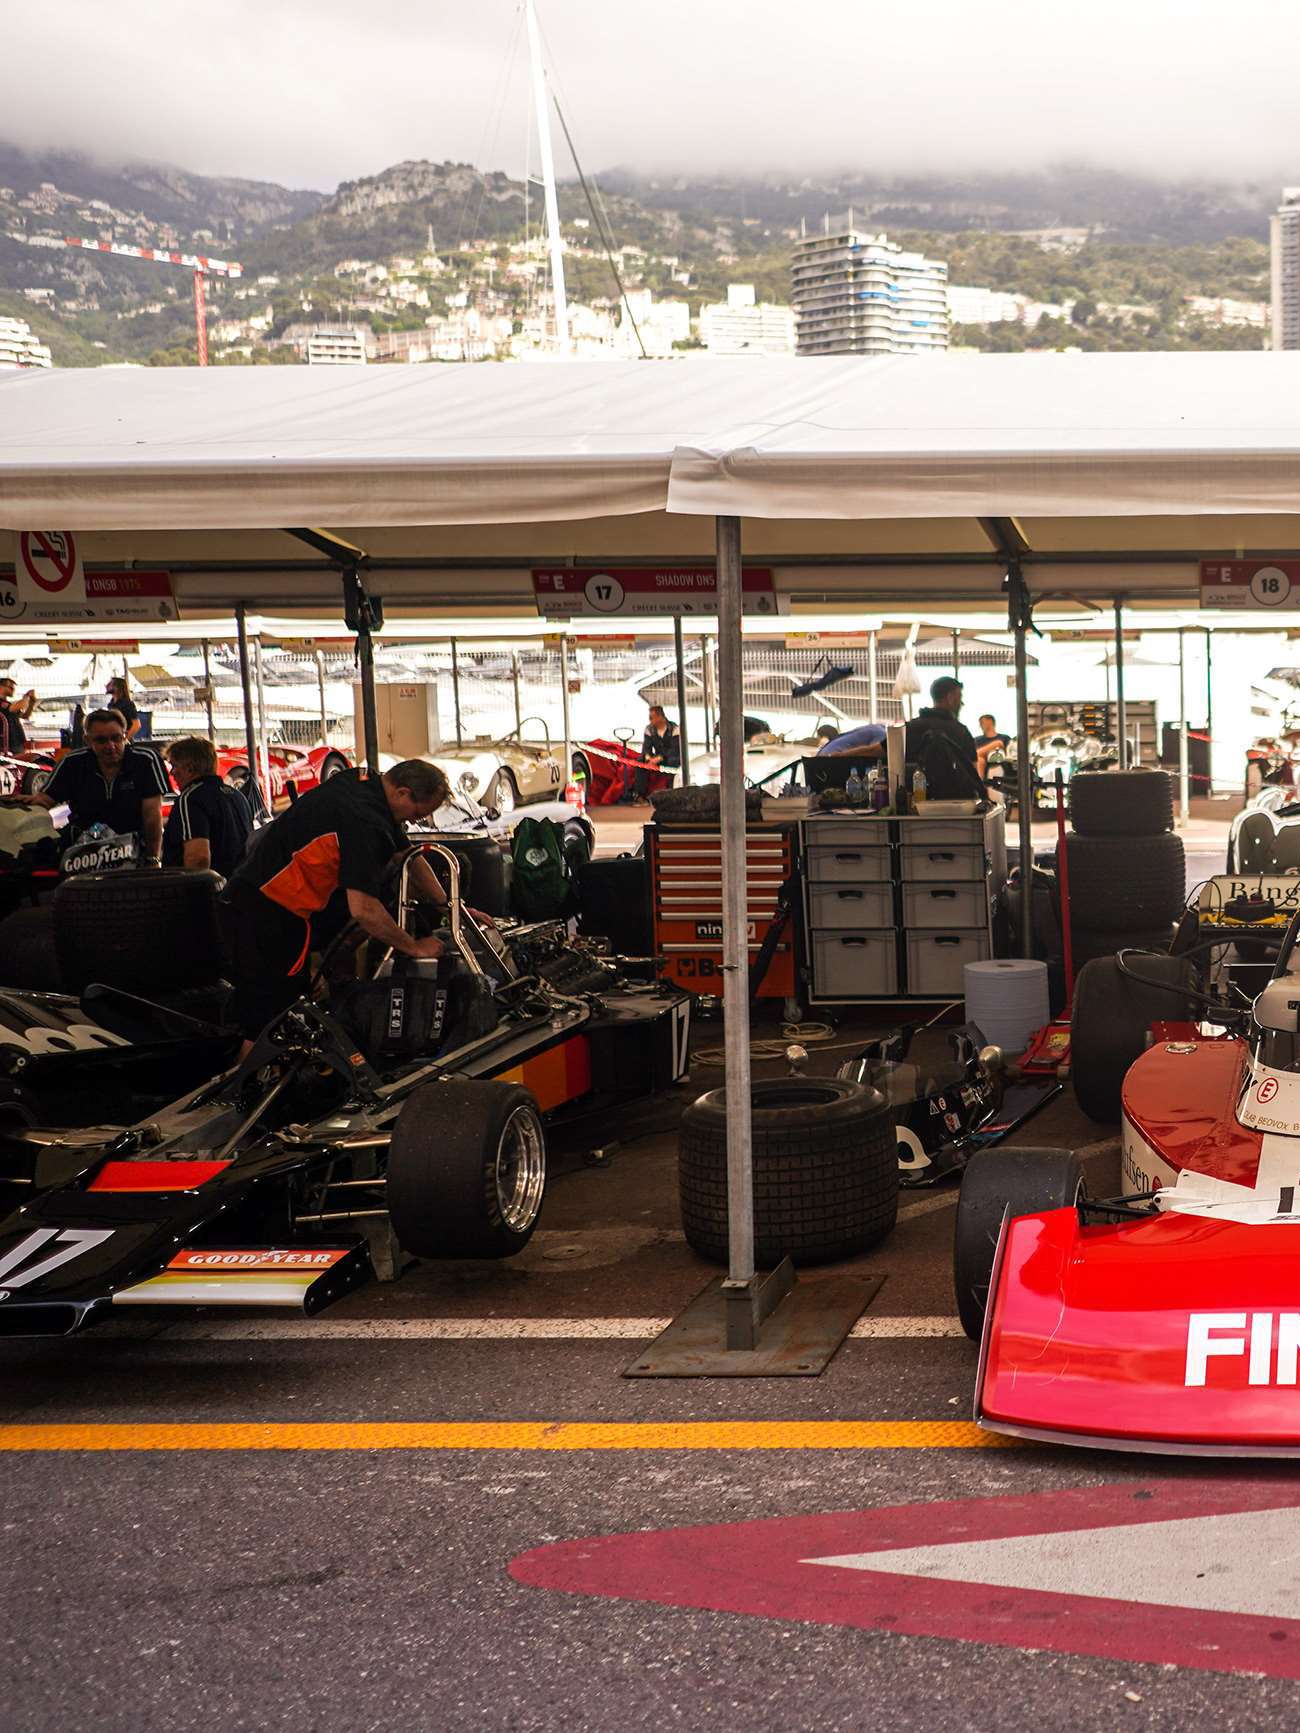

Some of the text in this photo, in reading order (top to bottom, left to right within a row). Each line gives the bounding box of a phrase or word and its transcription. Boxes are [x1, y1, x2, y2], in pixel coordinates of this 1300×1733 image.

[655, 575, 694, 586] SHADOW
[1221, 567, 1232, 582] E
[553, 575, 565, 590] E
[1261, 578, 1280, 593] 18
[595, 585, 612, 600] 17
[64, 844, 133, 873] GOODYEAR
[1230, 881, 1300, 907] Bang
[391, 998, 402, 1028] TRS
[1260, 1082, 1275, 1098] E
[1258, 1116, 1288, 1130] BEOVOX
[0, 1228, 116, 1287] 17
[188, 1250, 331, 1266] GOODYEAR
